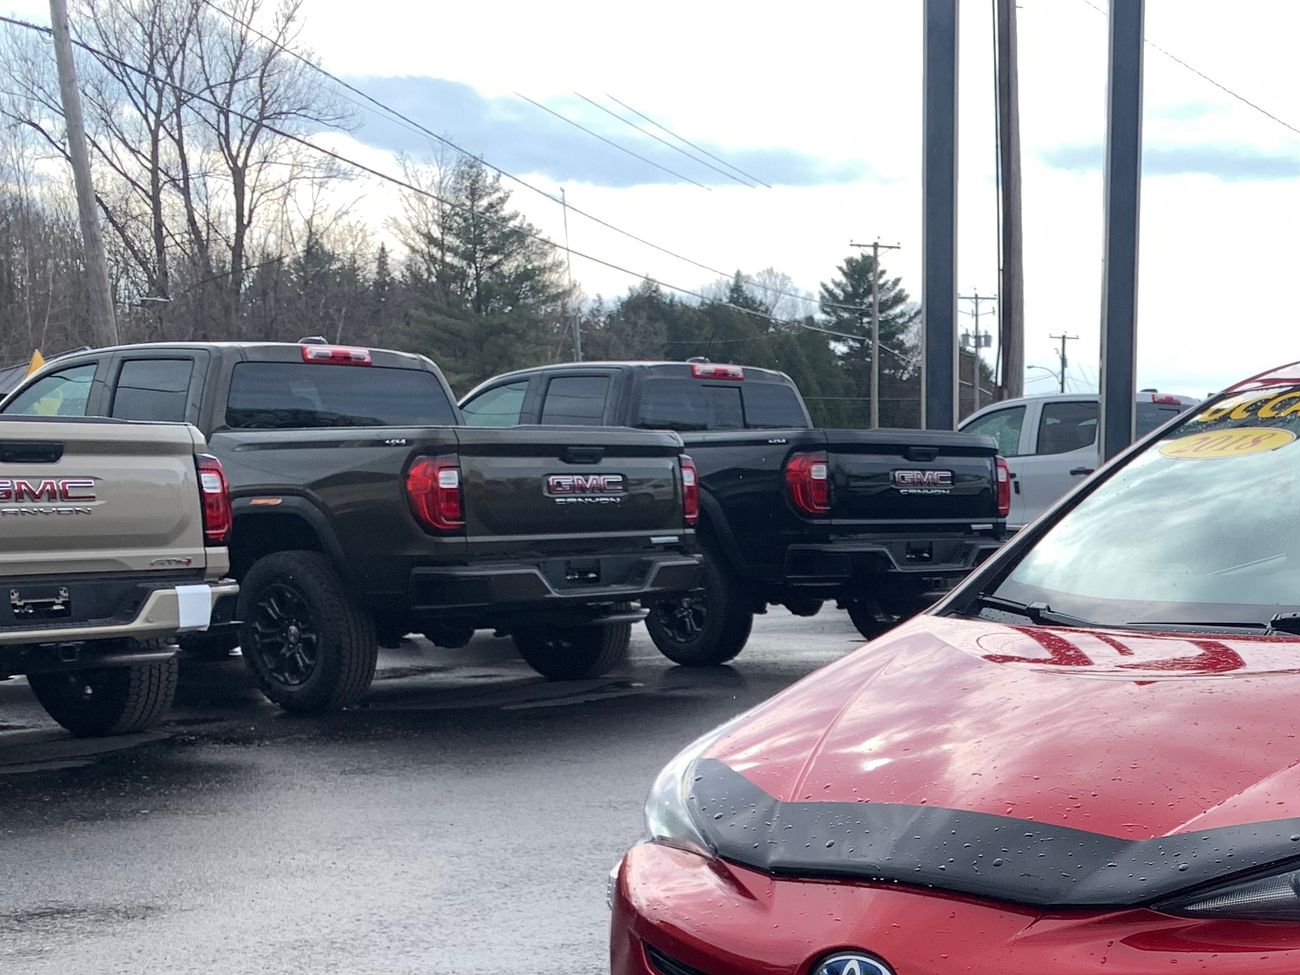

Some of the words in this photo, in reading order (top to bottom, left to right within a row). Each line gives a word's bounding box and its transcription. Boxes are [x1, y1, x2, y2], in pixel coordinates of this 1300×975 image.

[1168, 432, 1277, 455] 2018
[549, 475, 623, 494] GMC
[895, 470, 952, 487] GMC
[0, 507, 93, 516] ANYON
